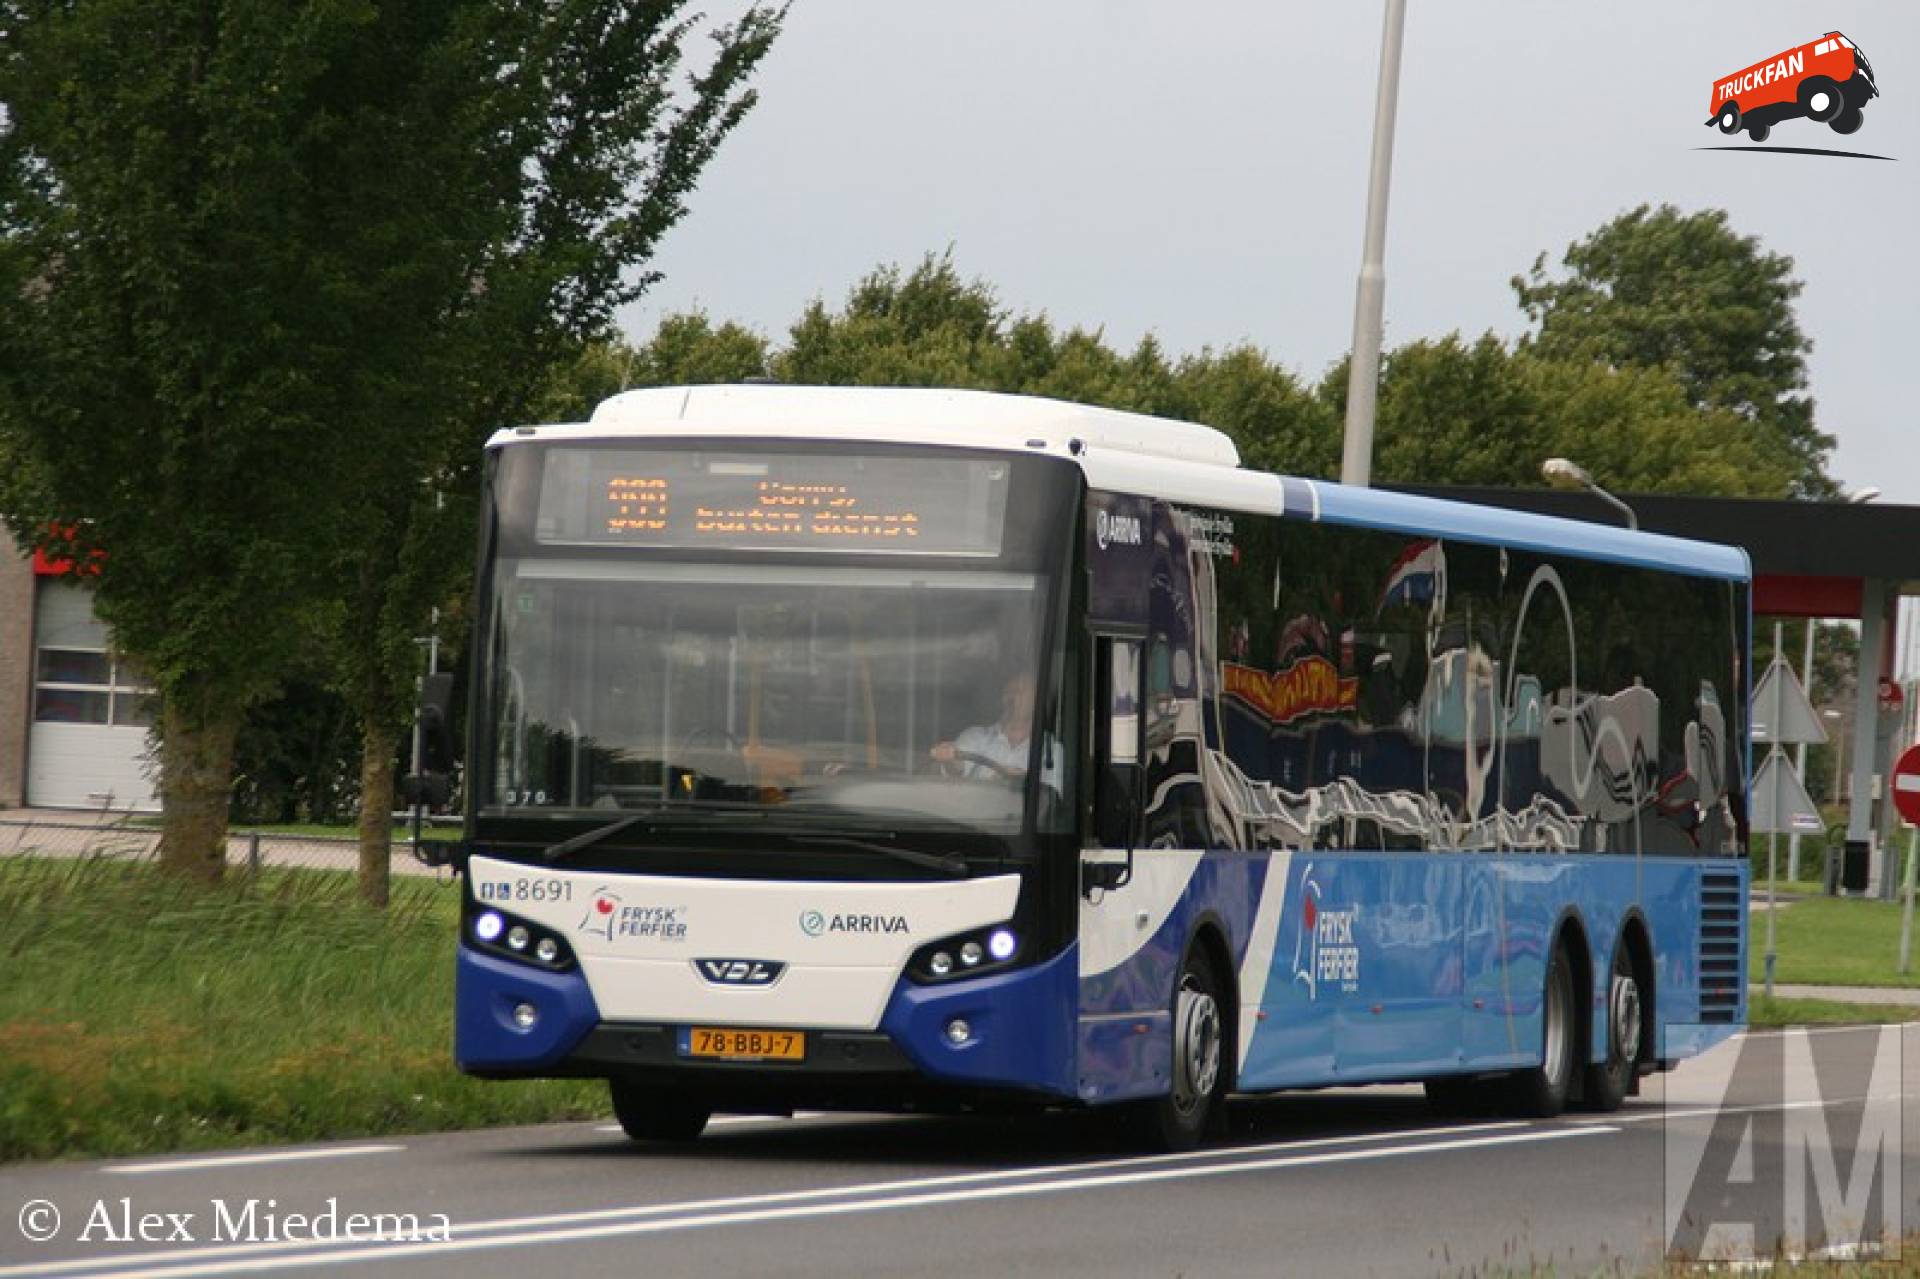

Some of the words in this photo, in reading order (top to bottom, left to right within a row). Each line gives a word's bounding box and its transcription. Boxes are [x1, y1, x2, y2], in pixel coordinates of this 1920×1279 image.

[515, 880, 573, 901] 8691
[621, 906, 676, 922] FRYSK
[618, 922, 687, 937] FERFIER
[829, 915, 910, 934] ARRIVA
[1319, 911, 1354, 944] FRYSK
[705, 961, 771, 979] VDL
[700, 1031, 794, 1054] 78-BBJ-7
